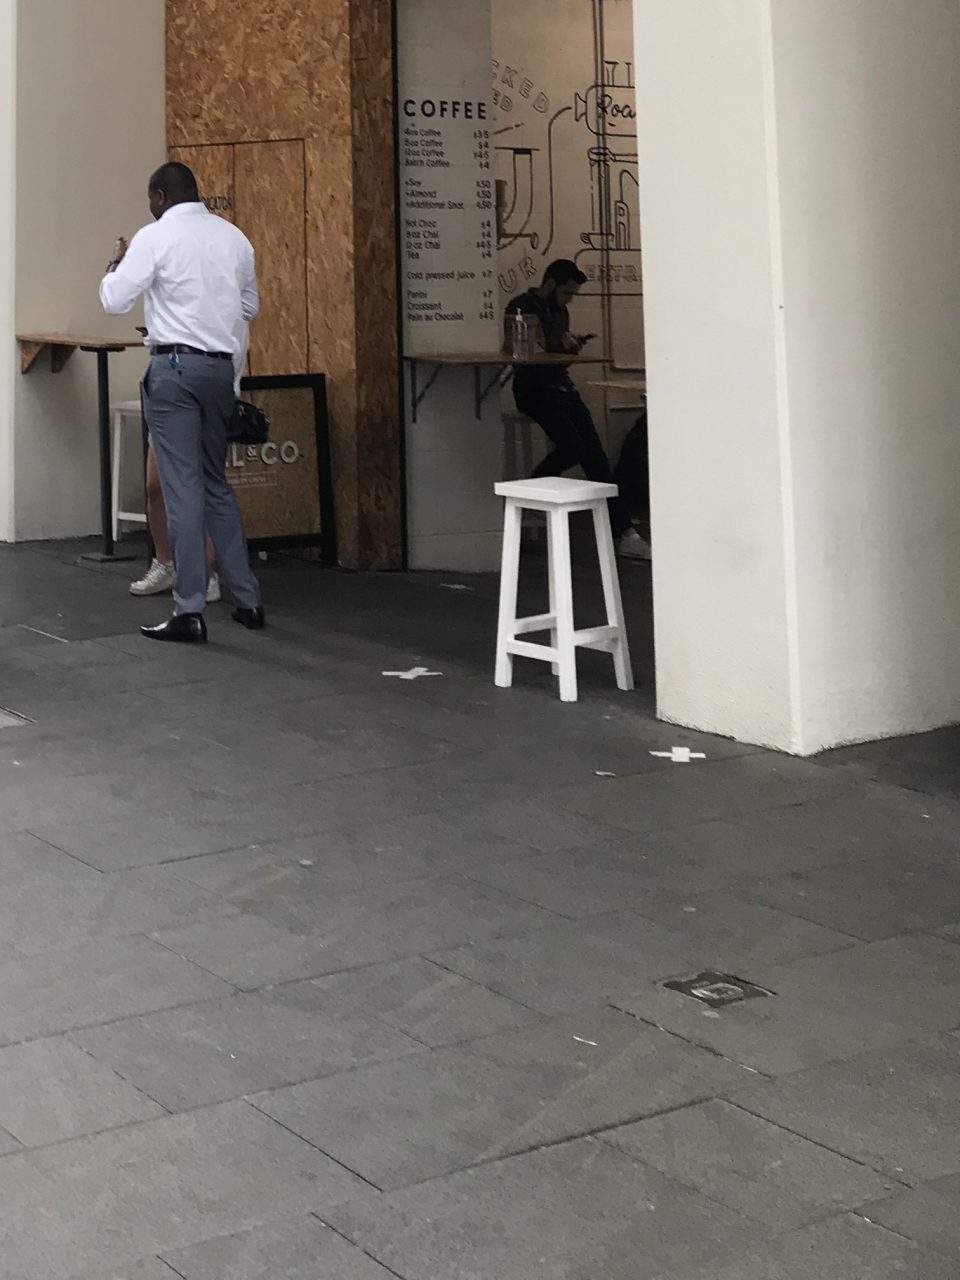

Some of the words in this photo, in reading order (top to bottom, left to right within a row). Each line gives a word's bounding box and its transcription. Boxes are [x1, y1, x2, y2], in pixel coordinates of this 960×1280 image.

[403, 100, 486, 119] COFFEE
[419, 128, 441, 137] Coffee
[420, 139, 443, 148] Coffee
[421, 149, 445, 158] Coffee
[426, 159, 450, 168] Coffee
[406, 219, 417, 228] Hot
[418, 219, 437, 228] Choc
[422, 230, 439, 239] Chai
[424, 240, 440, 250] Chai
[406, 250, 420, 260] Tea
[407, 271, 422, 280] Cold
[425, 271, 454, 281] pressed
[407, 289, 428, 298] Panini
[407, 302, 442, 311] Croissant
[407, 312, 422, 322] Pain
[434, 312, 464, 321] Chocolat
[225, 440, 300, 468] L&CO
